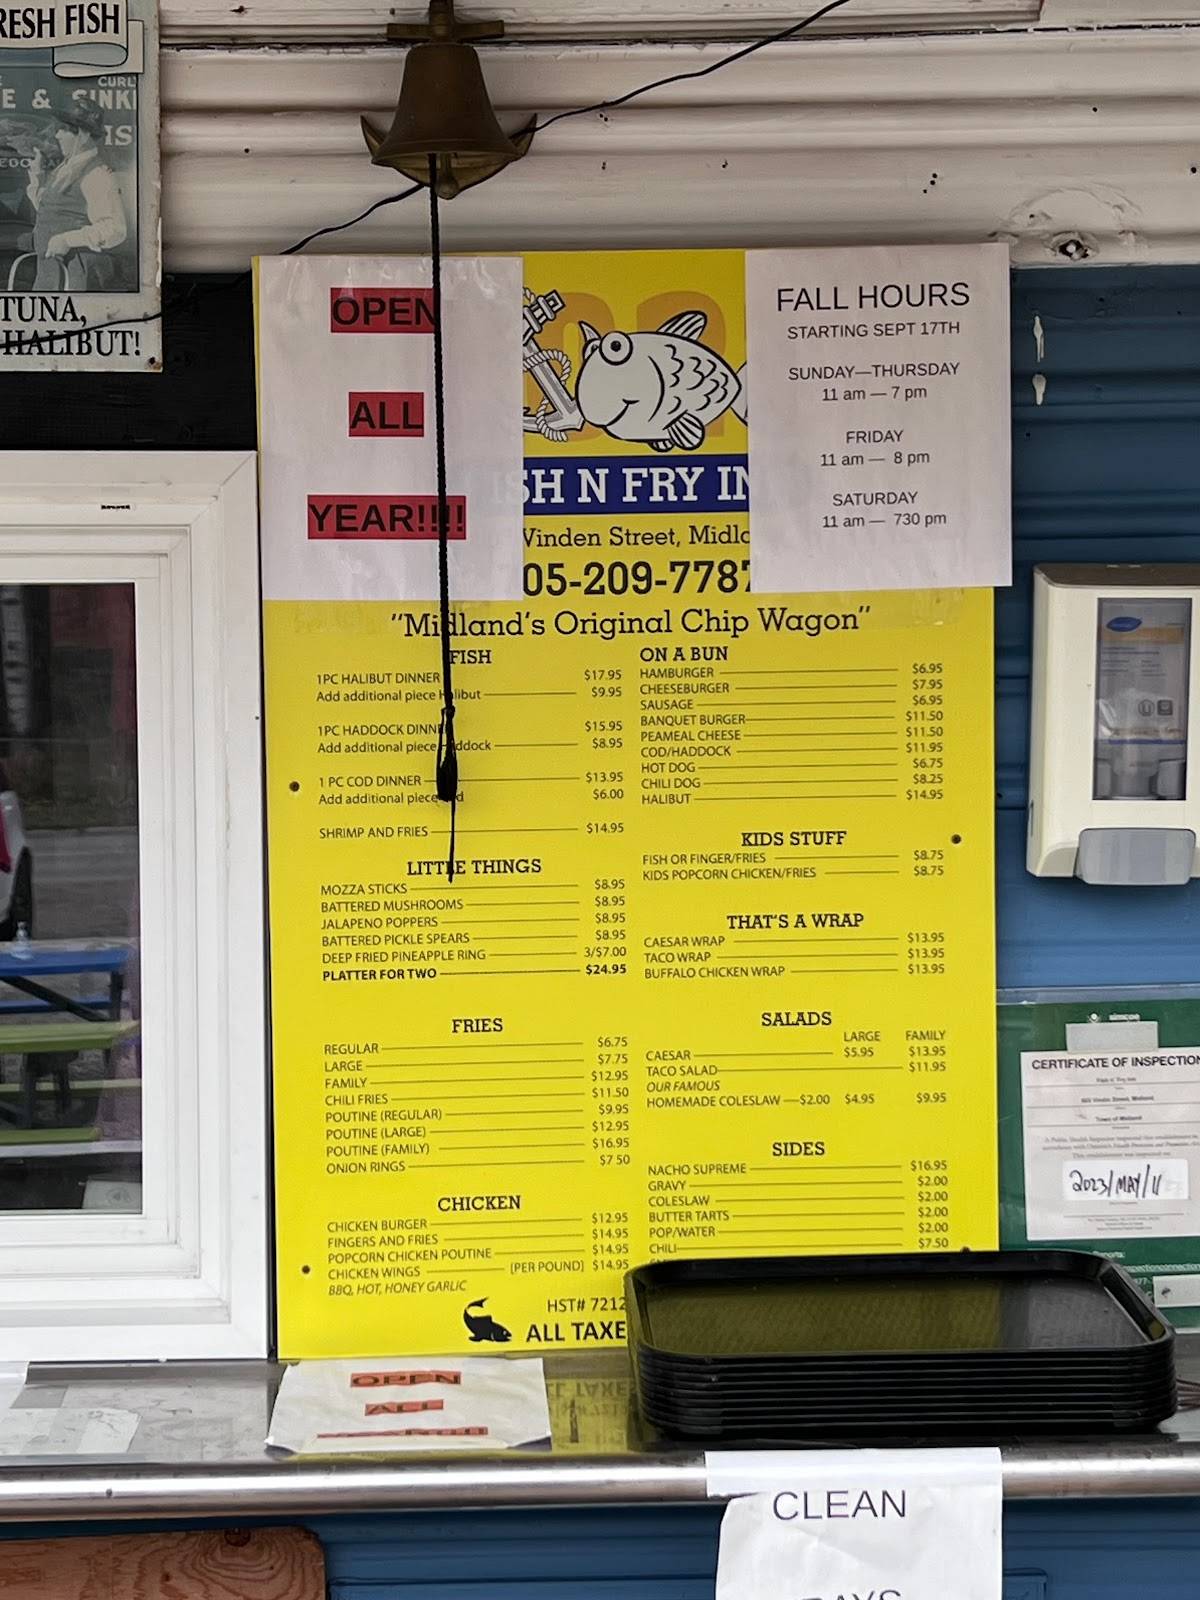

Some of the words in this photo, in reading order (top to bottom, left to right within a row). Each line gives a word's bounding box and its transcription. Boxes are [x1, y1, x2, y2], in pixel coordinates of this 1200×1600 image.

[0, 8, 55, 39] RESH
[65, 3, 119, 35] FISH
[777, 286, 849, 312] FALL
[859, 282, 970, 309] HOURS
[0, 296, 86, 327] TUNA,
[332, 296, 438, 326] OPEN
[787, 324, 868, 340] STARTING
[873, 322, 916, 337] SEPT
[920, 321, 960, 335] 17TH
[2, 330, 140, 356] HALIBUT!
[822, 388, 838, 401] 11
[843, 388, 866, 400] am
[890, 386, 900, 399] 7
[904, 386, 928, 402] pm
[350, 401, 424, 430] ALL
[846, 430, 904, 444] FRIDAY
[820, 454, 836, 467] 11
[841, 454, 864, 466] am
[893, 451, 903, 464] 8
[907, 452, 930, 467] pm
[577, 468, 609, 503] N
[621, 466, 704, 502] FRY
[832, 491, 918, 506] SATURDAY
[822, 515, 838, 528] 11
[843, 517, 865, 527] am
[893, 513, 920, 526] 730
[924, 513, 947, 528] pm
[523, 527, 602, 547] Vinden
[609, 526, 681, 547] Street,
[554, 609, 673, 640] Original
[681, 608, 749, 638] Chip
[450, 650, 492, 664] FISH
[640, 647, 668, 663] ON
[672, 646, 686, 662] A
[690, 646, 728, 661] BUN
[317, 673, 339, 685] 1PC
[341, 673, 392, 684] HALIBUT
[395, 672, 440, 684] DINNER
[584, 669, 622, 681] $17.95
[640, 667, 714, 679] HAMBURGER
[912, 663, 943, 675] $6.95
[316, 690, 340, 702] Add
[343, 689, 402, 702] additional
[405, 690, 436, 703] piece
[591, 686, 622, 698] $9.95
[640, 682, 730, 695] CHEESEBURGER
[640, 699, 694, 711] SAUSAGE
[343, 724, 404, 736] HADDOCK
[585, 720, 623, 732] $15.95
[641, 714, 697, 727] BANQUET
[699, 714, 746, 725] BURGER
[641, 730, 695, 742] PEAMEAL
[697, 729, 741, 741] CHEESE
[592, 737, 623, 750] $8.95
[641, 745, 731, 758] COD/HADDOCK
[641, 762, 666, 774] HOT
[668, 761, 696, 773] DOG
[346, 776, 373, 787] COD
[376, 775, 422, 787] DINNER
[586, 771, 624, 784] $13.95
[913, 773, 943, 785] $8.25
[593, 788, 624, 800] $6.00
[319, 827, 364, 839] SHRIMP
[367, 827, 395, 838] AND
[397, 826, 428, 837] FRIES
[586, 822, 624, 834] $14.95
[741, 831, 784, 847] KIDS
[789, 831, 847, 846] STUFF
[643, 854, 668, 865] FISH
[670, 854, 687, 865] OR
[690, 852, 766, 864] FINGER/FRIES
[406, 860, 466, 876] LITTLE
[471, 858, 542, 874] THINGS
[643, 870, 669, 881] KIDS
[672, 869, 728, 880] POPCORN
[731, 867, 817, 879] CHICKEN/FRIES
[321, 884, 365, 896] MOZZA
[368, 883, 408, 895] STICKS
[594, 878, 625, 890] $8.95
[321, 901, 381, 913] BATTERED
[383, 898, 464, 911] MUSHROOMS
[321, 917, 383, 930] JALAPENO
[386, 916, 438, 928] POPPERS
[727, 914, 789, 929] THAT'S
[793, 915, 807, 929] A
[811, 913, 864, 928] WRAP
[384, 933, 423, 945] PICKLE
[426, 932, 470, 944] SPEARS
[644, 936, 689, 948] CAESAR
[691, 935, 725, 947] WRAP
[322, 952, 352, 964] DEEP
[355, 951, 389, 963] FRIED
[391, 950, 454, 962] PINEAPPLE
[457, 949, 486, 960] RING
[584, 946, 627, 958] 3/$7.00
[644, 952, 675, 963] TACO
[323, 969, 377, 981] PLATTER
[380, 969, 405, 980] FOR
[407, 968, 437, 979] TWO
[586, 964, 627, 976] $24.95
[645, 967, 696, 979] BUFFALO
[698, 966, 749, 978] CHICKEN
[451, 1017, 503, 1034] FRIES
[761, 1011, 833, 1027] SALADS
[844, 1031, 881, 1042] LARGE
[324, 1043, 379, 1055] REGULAR
[597, 1036, 628, 1048] $6.75
[645, 1050, 691, 1061] CAESAR
[324, 1060, 363, 1072] LARGE
[679, 1064, 718, 1076] SALAD
[1031, 1058, 1109, 1070] CERTIFICATE
[1111, 1057, 1129, 1068] OF
[325, 1077, 367, 1089] FAMILY
[673, 1080, 720, 1092] FAMOUS
[325, 1094, 355, 1106] CHILI
[358, 1093, 388, 1105] FRIES
[647, 1096, 716, 1108] HOMEMADE
[719, 1095, 781, 1107] COLESLAW
[325, 1110, 377, 1123] POUTINE
[380, 1108, 442, 1122] (REGULAR)
[380, 1126, 426, 1139] (LARGE)
[381, 1143, 430, 1156] (FAMILY)
[772, 1141, 826, 1156] SIDES
[326, 1162, 367, 1174] ONION
[370, 1160, 406, 1172] RINGS
[648, 1164, 691, 1176] NACHO
[693, 1163, 746, 1175] SUPREME
[648, 1180, 686, 1191] GRAVY
[437, 1195, 521, 1212] CHICKEN
[695, 1210, 730, 1222] TARTS
[327, 1220, 378, 1233] CHICKEN
[381, 1218, 427, 1231] BURGER
[328, 1236, 376, 1248] FINGERS
[387, 1249, 438, 1262] CHICKEN
[441, 1248, 491, 1260] POUTINE
[381, 1265, 421, 1278] WINGS
[547, 1298, 586, 1313] HST#
[526, 1323, 565, 1343] ALL
[570, 1321, 627, 1342] TAXE
[352, 1374, 460, 1385] OPEN
[773, 1490, 907, 1521] CLEAN
